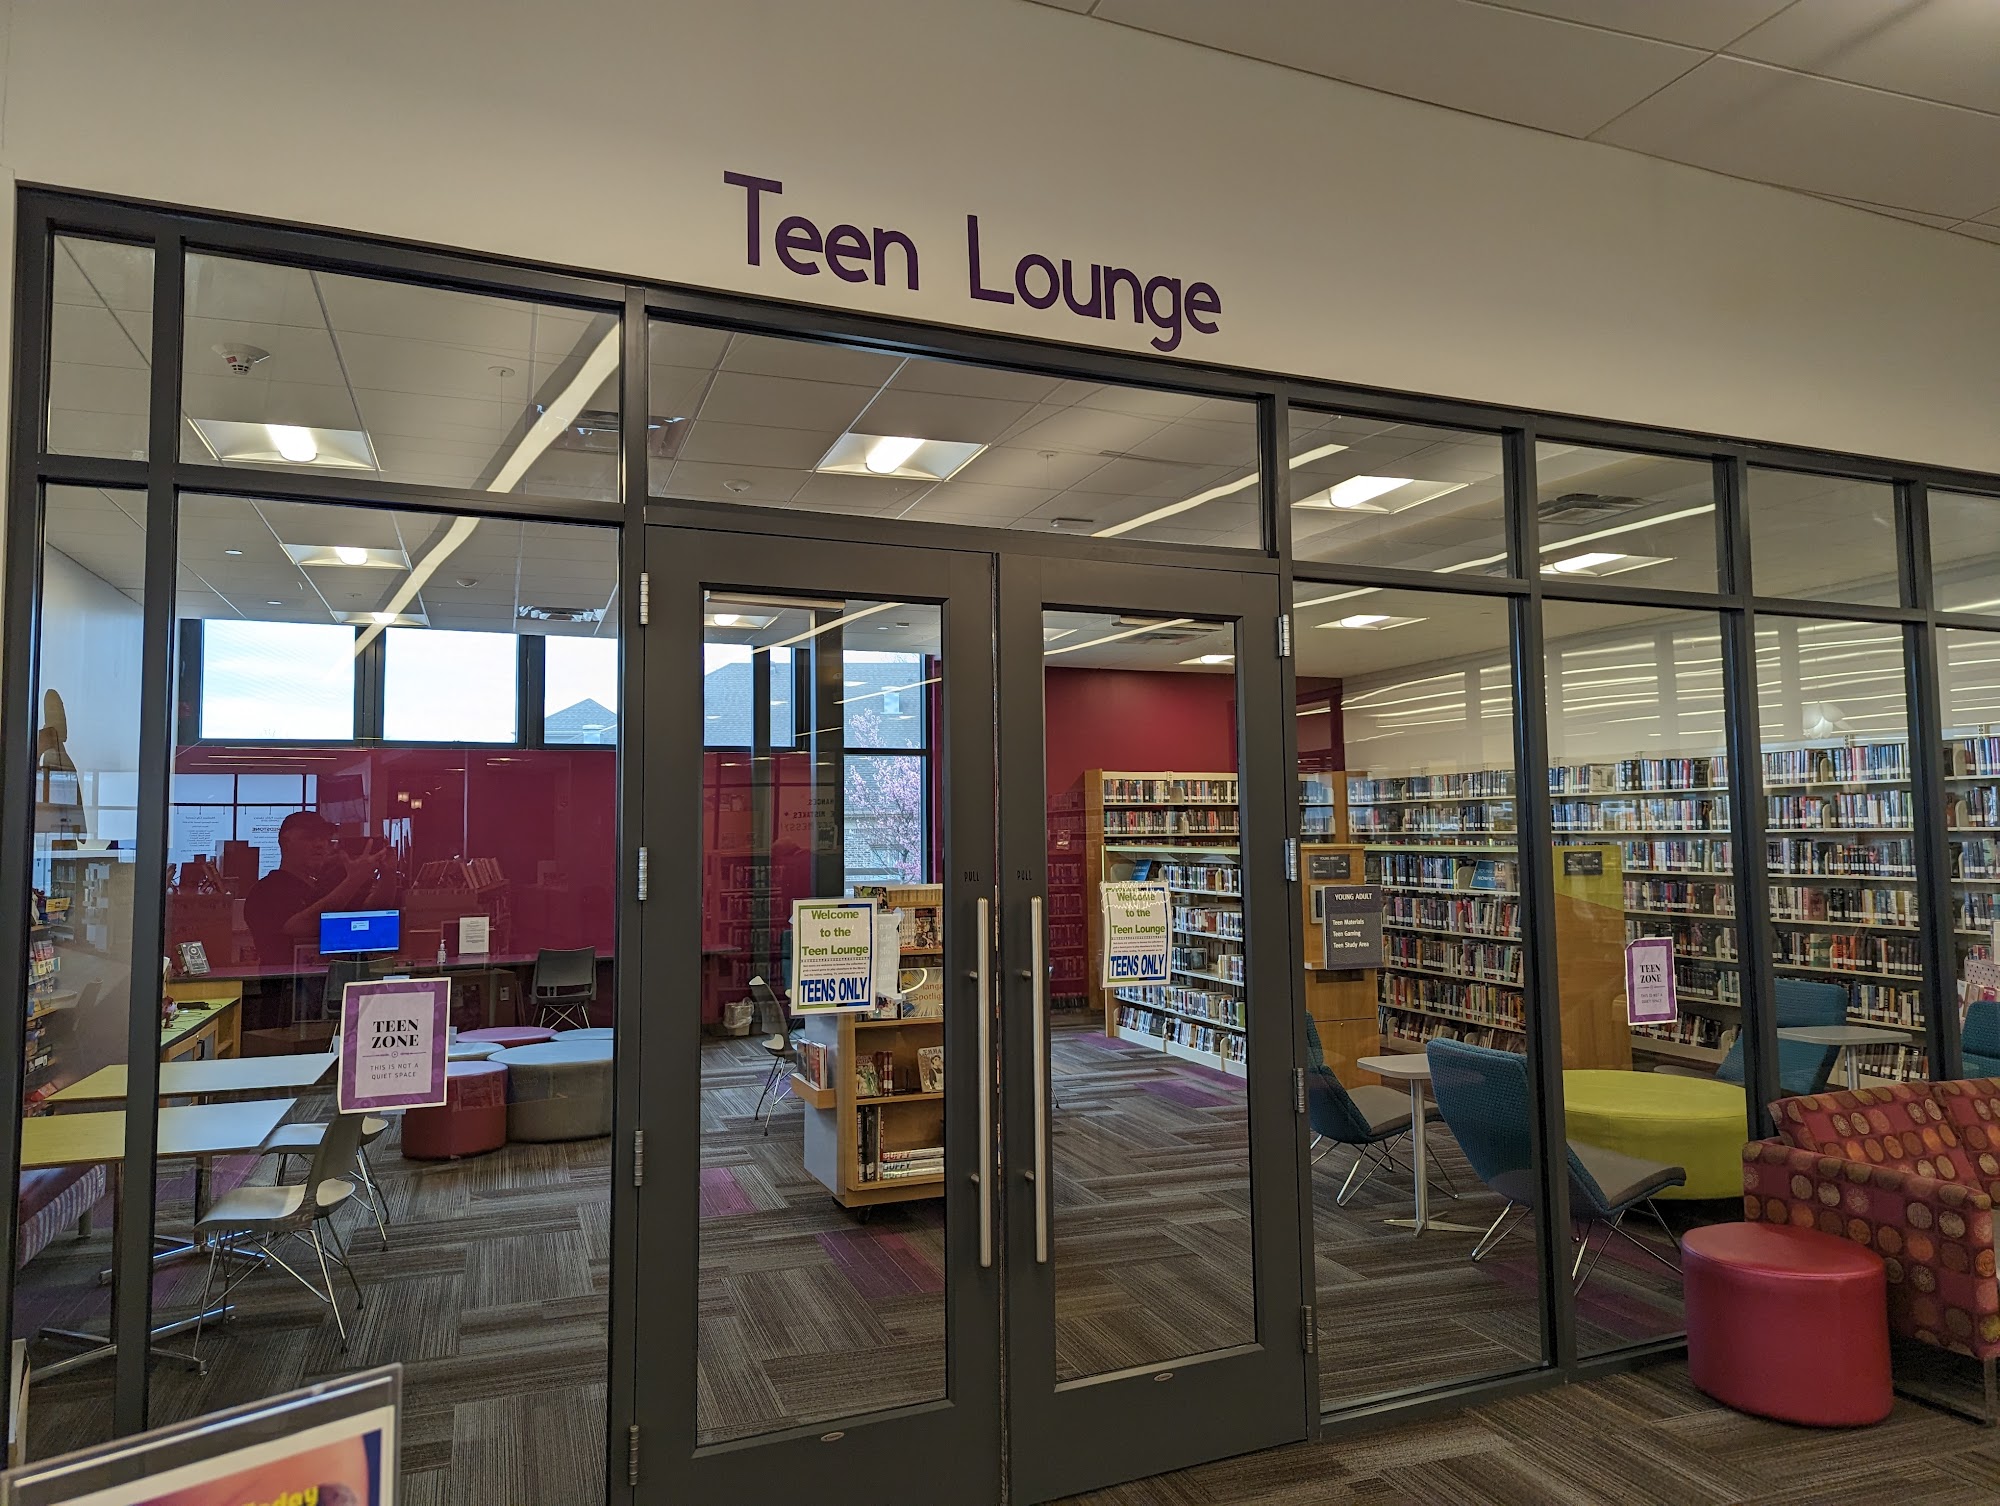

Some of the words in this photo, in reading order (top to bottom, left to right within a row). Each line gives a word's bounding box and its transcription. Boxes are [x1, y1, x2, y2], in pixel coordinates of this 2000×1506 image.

[724, 170, 919, 290] Teen
[966, 214, 1222, 353] Lounge
[964, 870, 980, 882] PULL
[1016, 870, 1032, 880] PULL
[1116, 892, 1155, 902] Welcome
[811, 910, 859, 920] Welcome
[820, 928, 830, 937] to
[834, 927, 851, 936] the
[1112, 925, 1133, 934] Teen
[1135, 924, 1165, 935] Lounge
[802, 946, 828, 955] Teen
[831, 945, 869, 956] Lounge
[1111, 954, 1139, 976] TEENS
[1141, 954, 1165, 975] ONLY
[1640, 964, 1661, 973] TEEN
[1640, 974, 1661, 983] ZONE
[801, 978, 836, 1002] TEENS
[838, 977, 868, 1000] ONLY
[913, 992, 942, 1001] Spotlig
[373, 1019, 419, 1033] TEEN
[372, 1034, 419, 1048] ZONE
